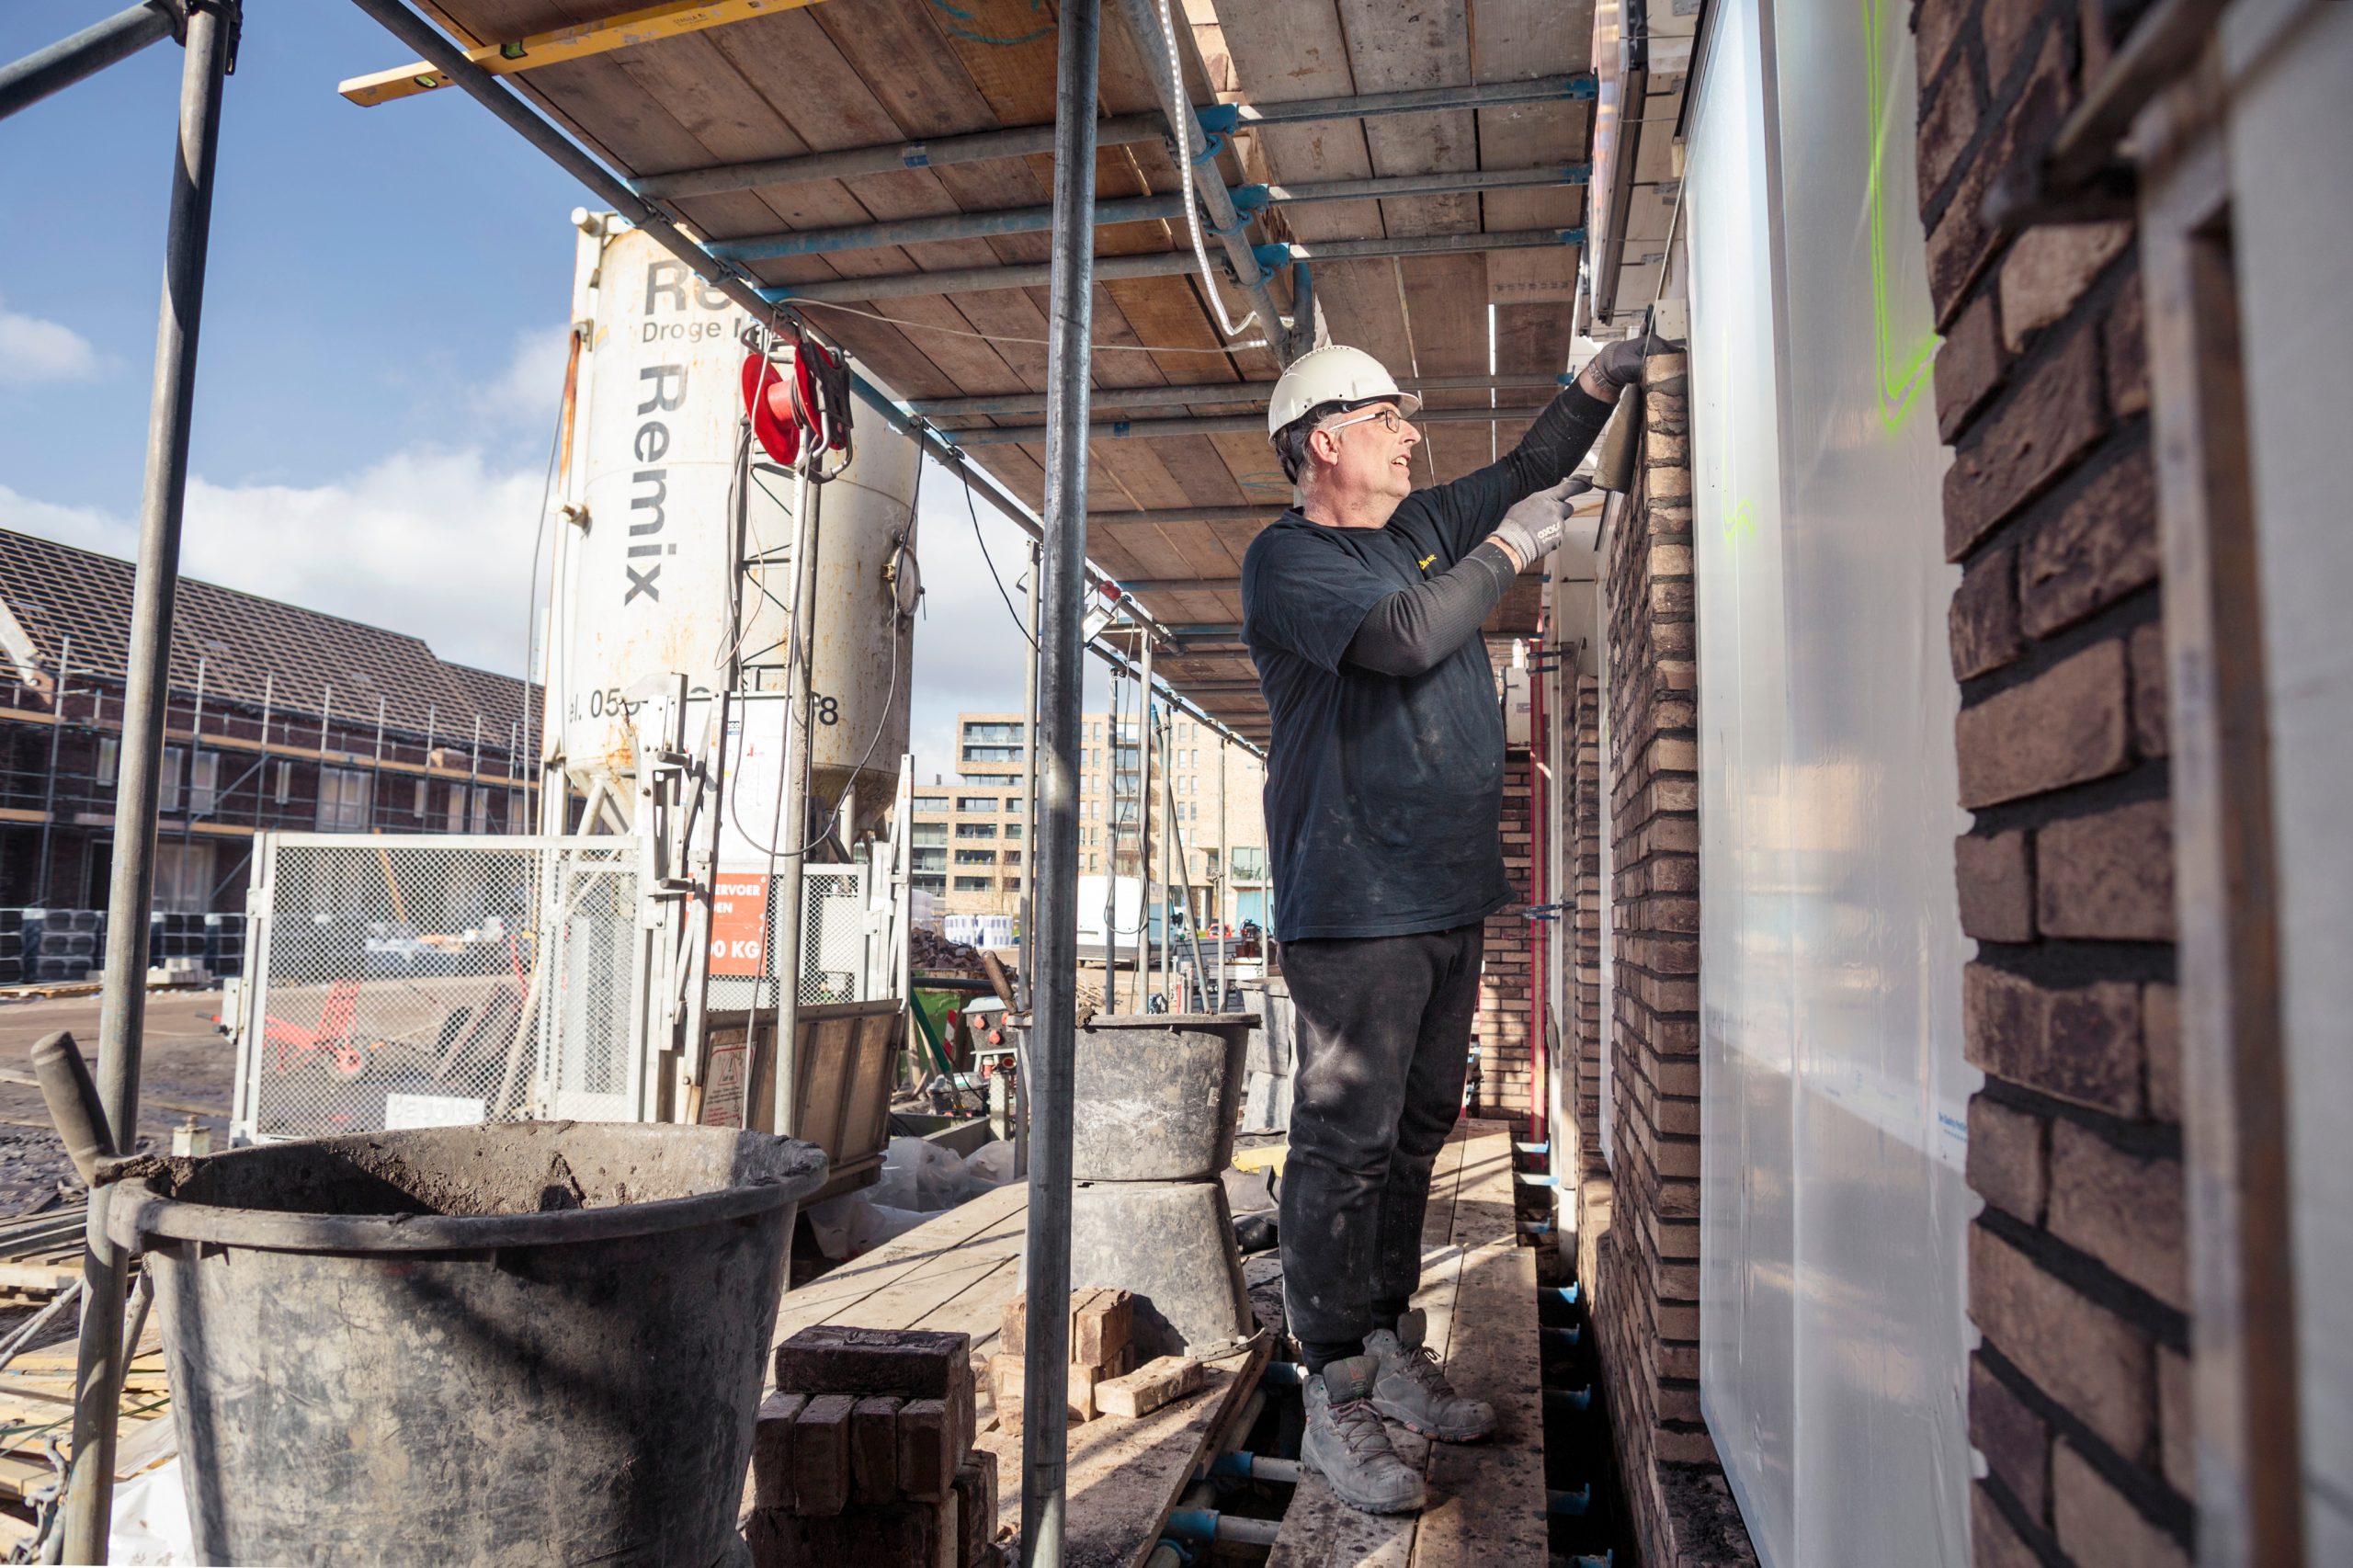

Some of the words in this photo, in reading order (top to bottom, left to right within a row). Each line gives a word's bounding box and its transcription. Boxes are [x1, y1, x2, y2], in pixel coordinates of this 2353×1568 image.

[642, 321, 722, 343] Droge
[624, 364, 688, 607] Remix
[732, 940, 760, 959] KG
